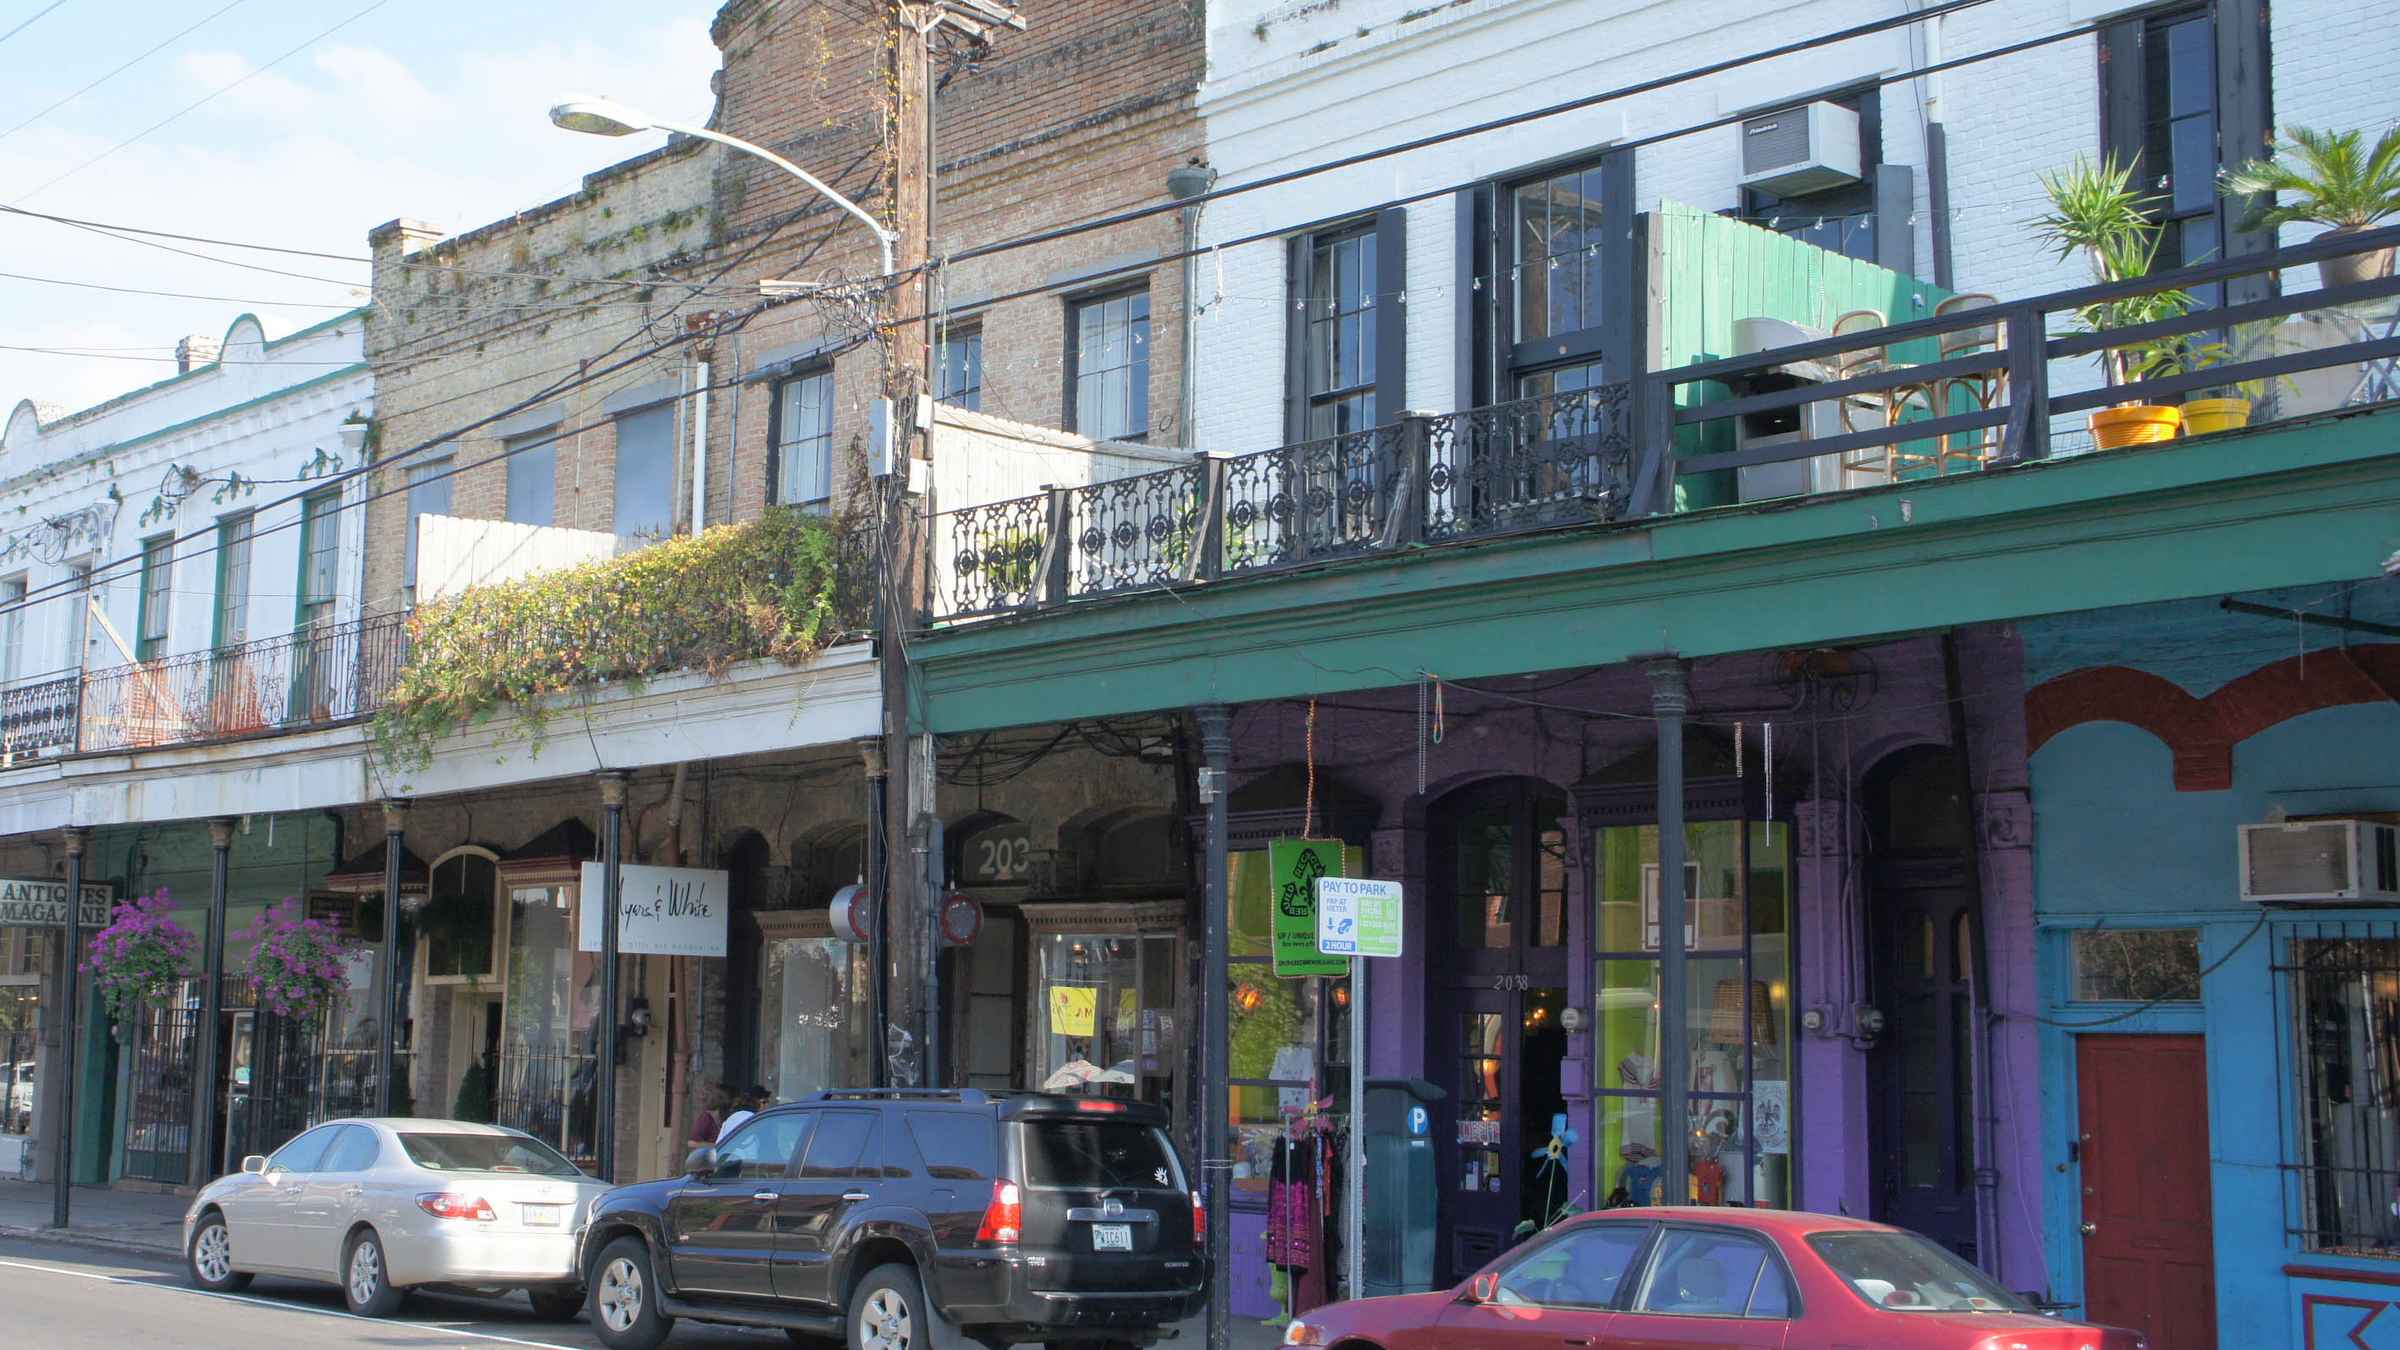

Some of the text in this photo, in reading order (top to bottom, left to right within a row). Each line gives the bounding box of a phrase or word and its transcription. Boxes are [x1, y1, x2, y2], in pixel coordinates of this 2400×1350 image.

[3, 883, 106, 904] ANTIQES
[668, 878, 712, 918] White
[1323, 881, 1386, 896] PAY TO PARK
[0, 901, 106, 923] MAGAZNE
[1330, 942, 1352, 951] HOUR
[1493, 975, 1528, 990] 2038
[1413, 1107, 1425, 1134] P
